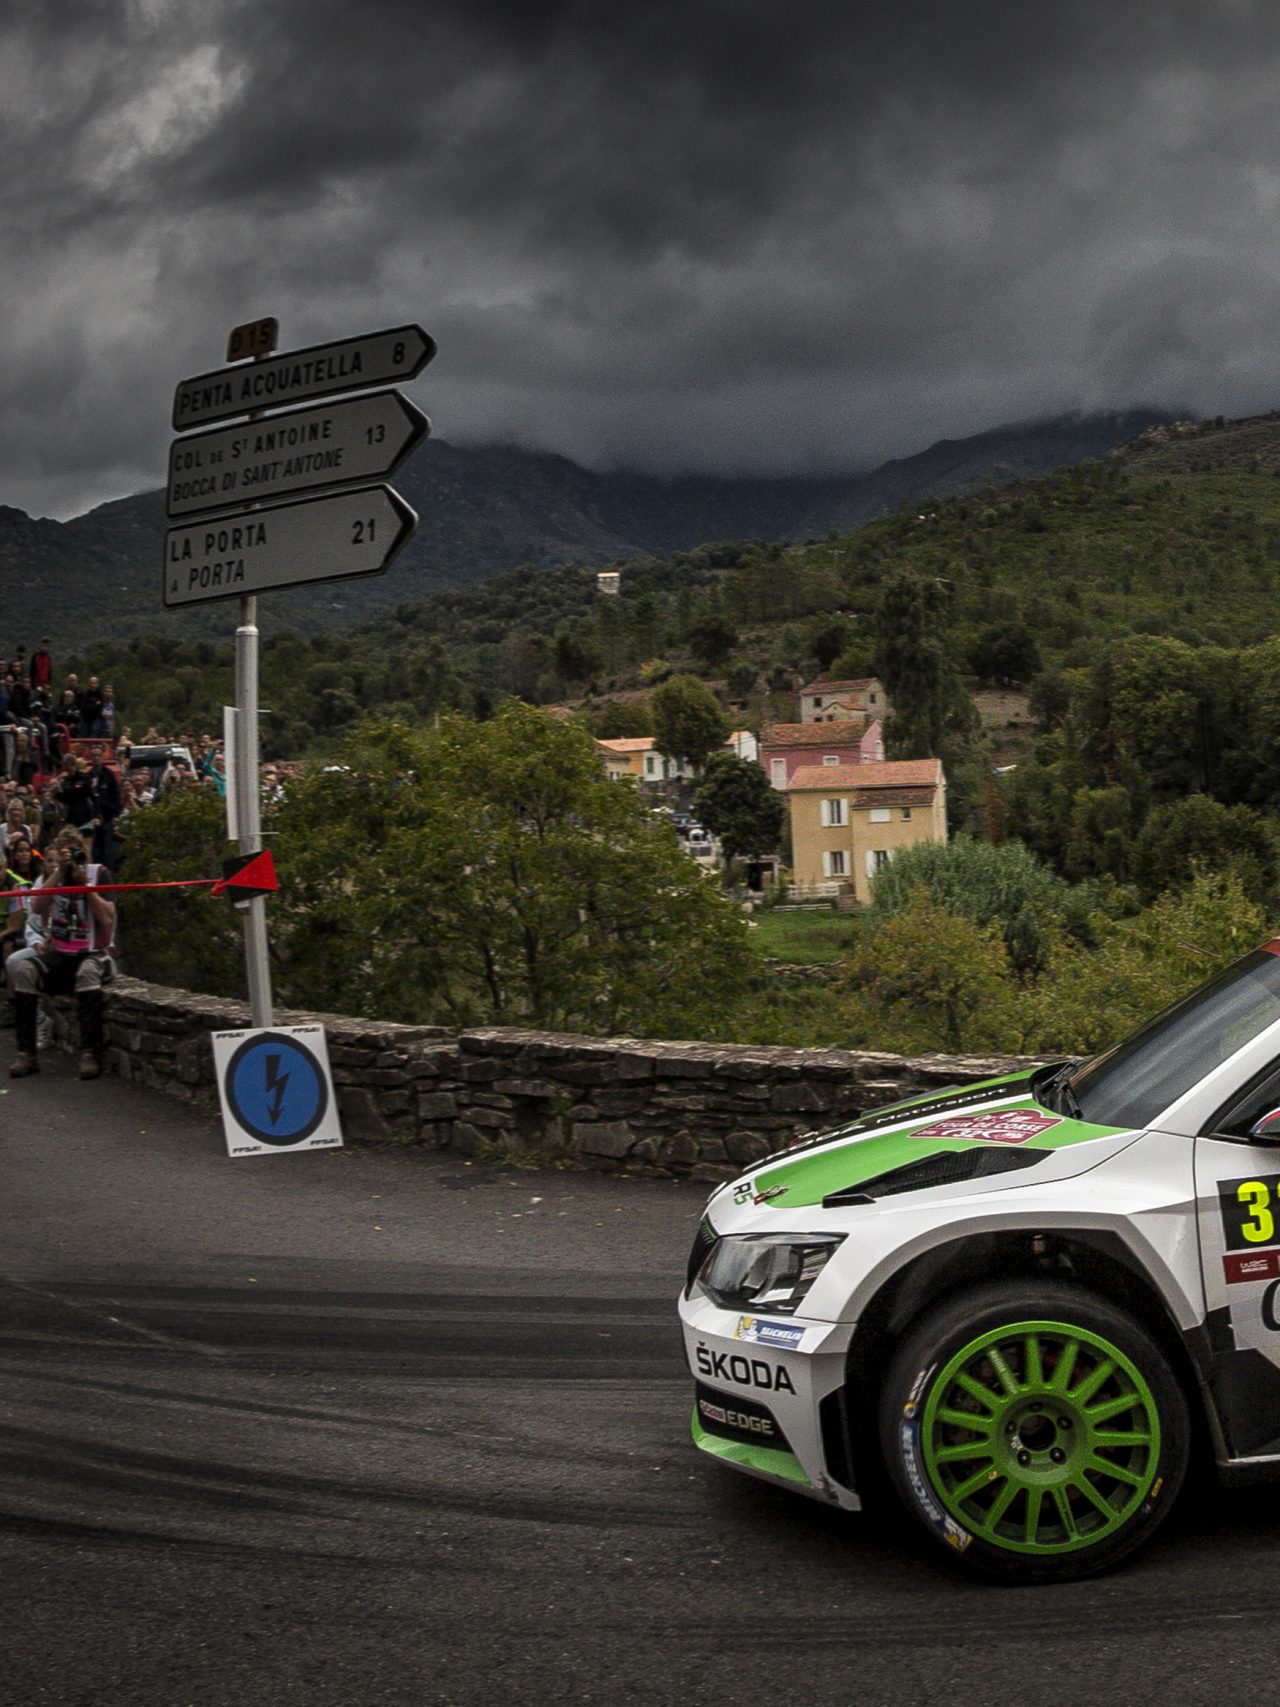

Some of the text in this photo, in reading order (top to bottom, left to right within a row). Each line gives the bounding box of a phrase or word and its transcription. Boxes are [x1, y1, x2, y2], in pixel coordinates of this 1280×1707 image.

[392, 341, 406, 366] 8
[179, 351, 363, 415] PENTA ACQUATELLA
[173, 450, 203, 473] COL
[254, 419, 333, 455] ANTOINE
[366, 424, 386, 446] 13
[173, 448, 345, 502] BOCCA DI SANT'ANTONE
[170, 521, 267, 563] LA PORTA
[352, 518, 377, 545] 21
[188, 558, 245, 591] PORTA
[733, 1182, 754, 1206] R5
[696, 1340, 798, 1396] ŠKODA
[726, 1410, 775, 1435] EDGE
